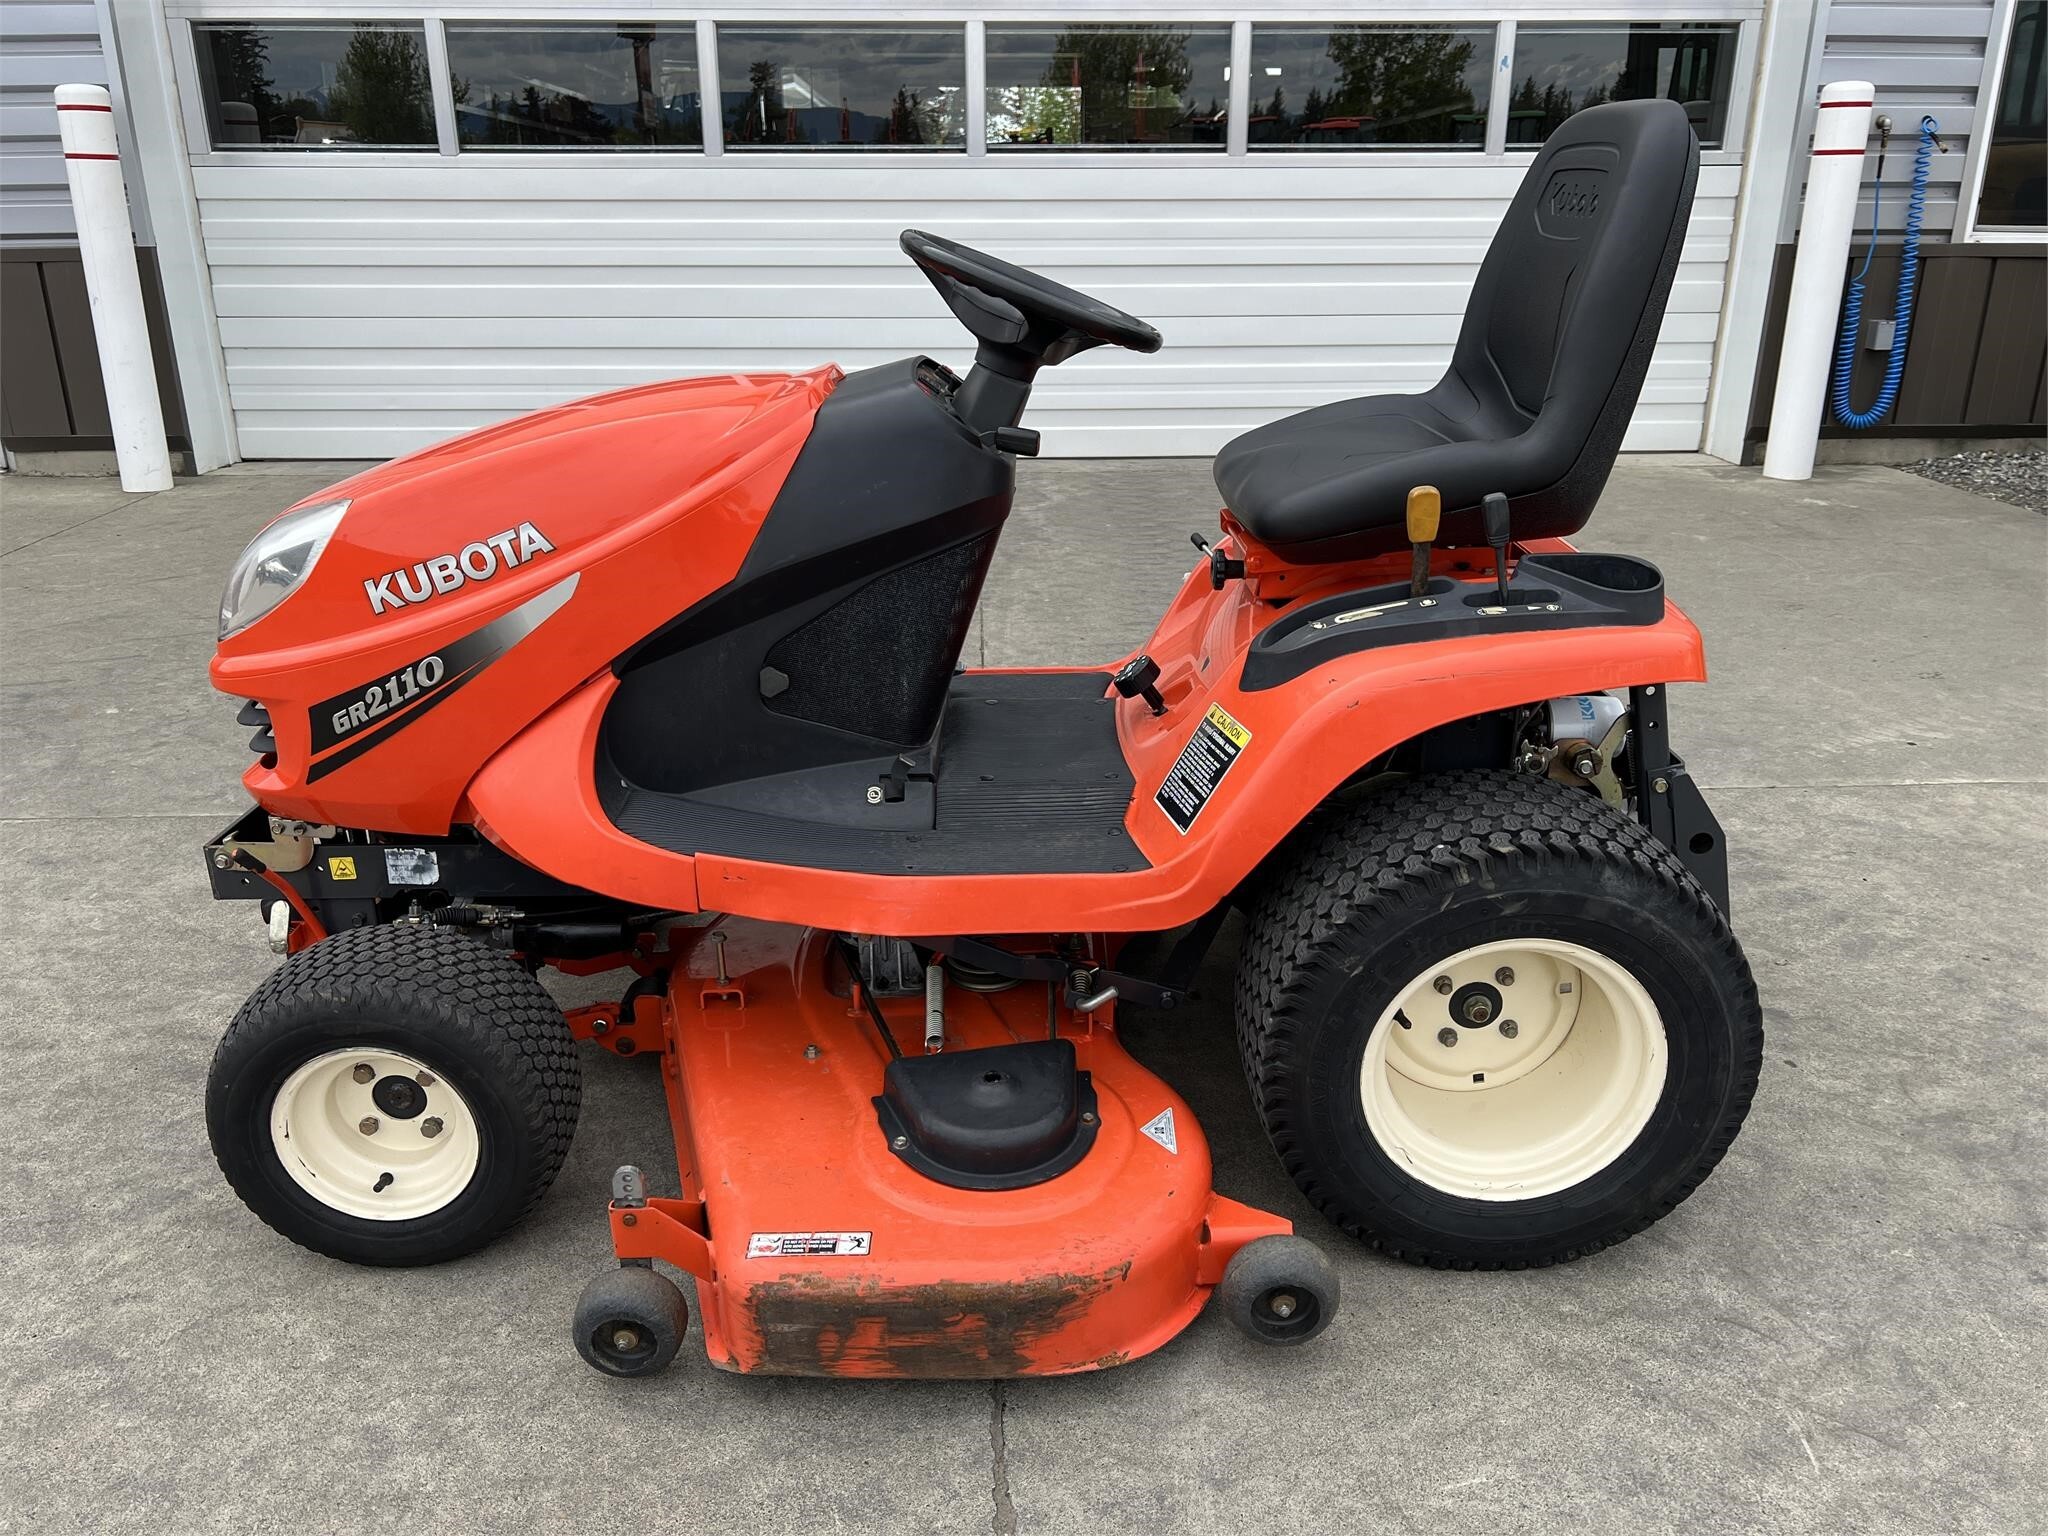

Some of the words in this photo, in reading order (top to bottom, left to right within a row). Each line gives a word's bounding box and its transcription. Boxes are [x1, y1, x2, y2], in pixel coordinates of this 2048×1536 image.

[362, 521, 557, 615] KUBOTA
[332, 655, 445, 735] GR2110
[1216, 715, 1243, 741] CAUTION
